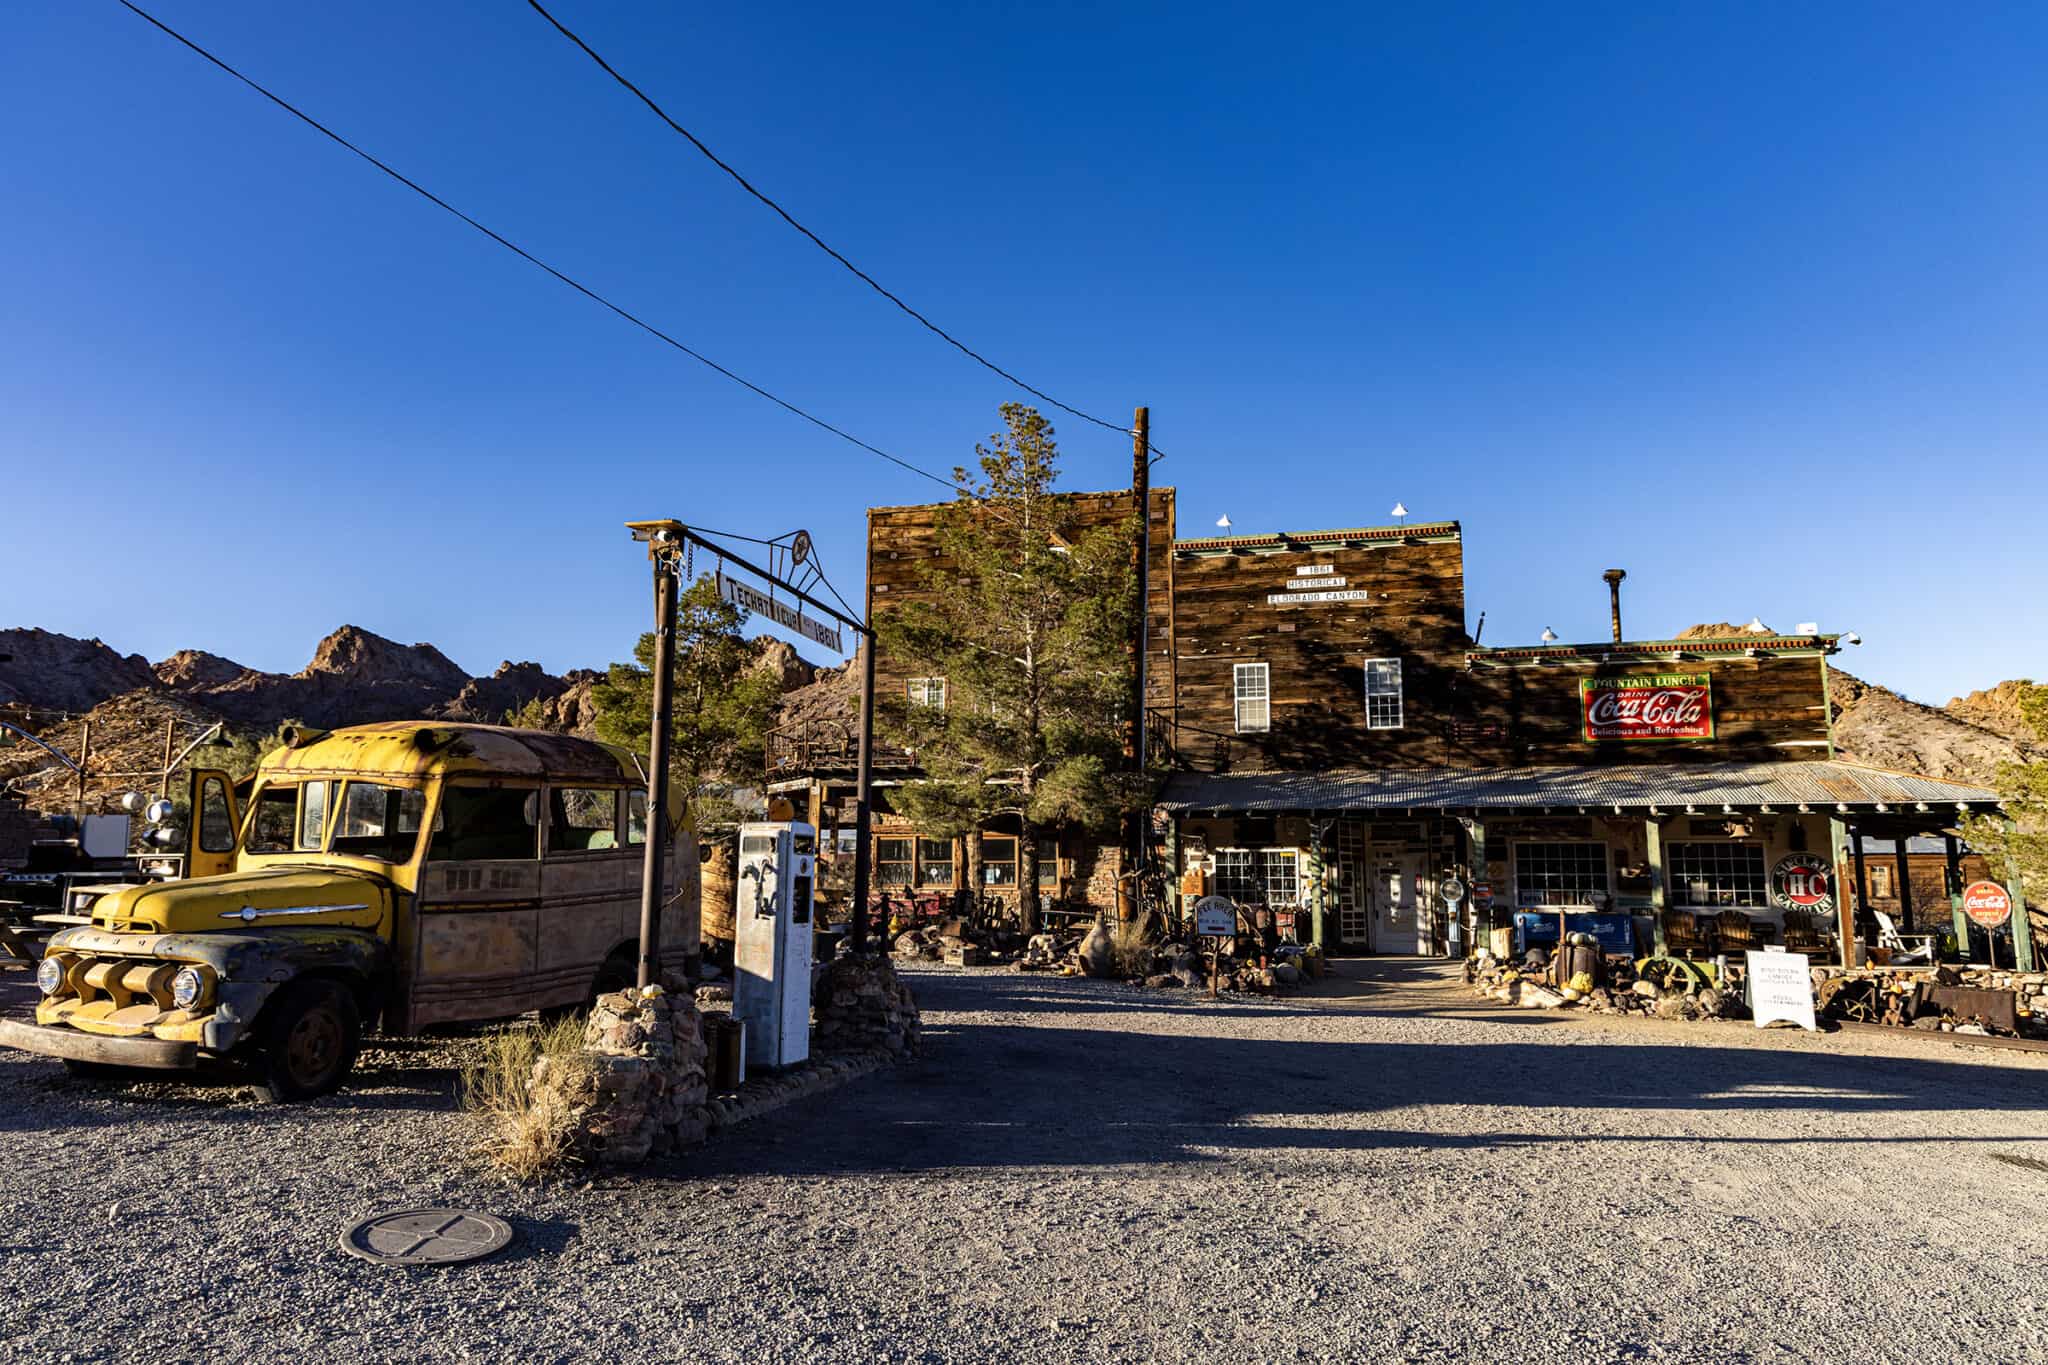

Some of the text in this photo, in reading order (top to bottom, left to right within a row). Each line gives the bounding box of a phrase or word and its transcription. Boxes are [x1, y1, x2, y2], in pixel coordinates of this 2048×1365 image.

[1309, 565, 1331, 574] 1861
[1287, 577, 1345, 589] HISTORICAL
[1269, 590, 1366, 603] ELDORADO CANYON
[1593, 675, 1696, 688] FOUNTAIN LUNCH
[1588, 690, 1705, 726] Coca-Cola
[1591, 725, 1705, 736] Delicious and Refreshing
